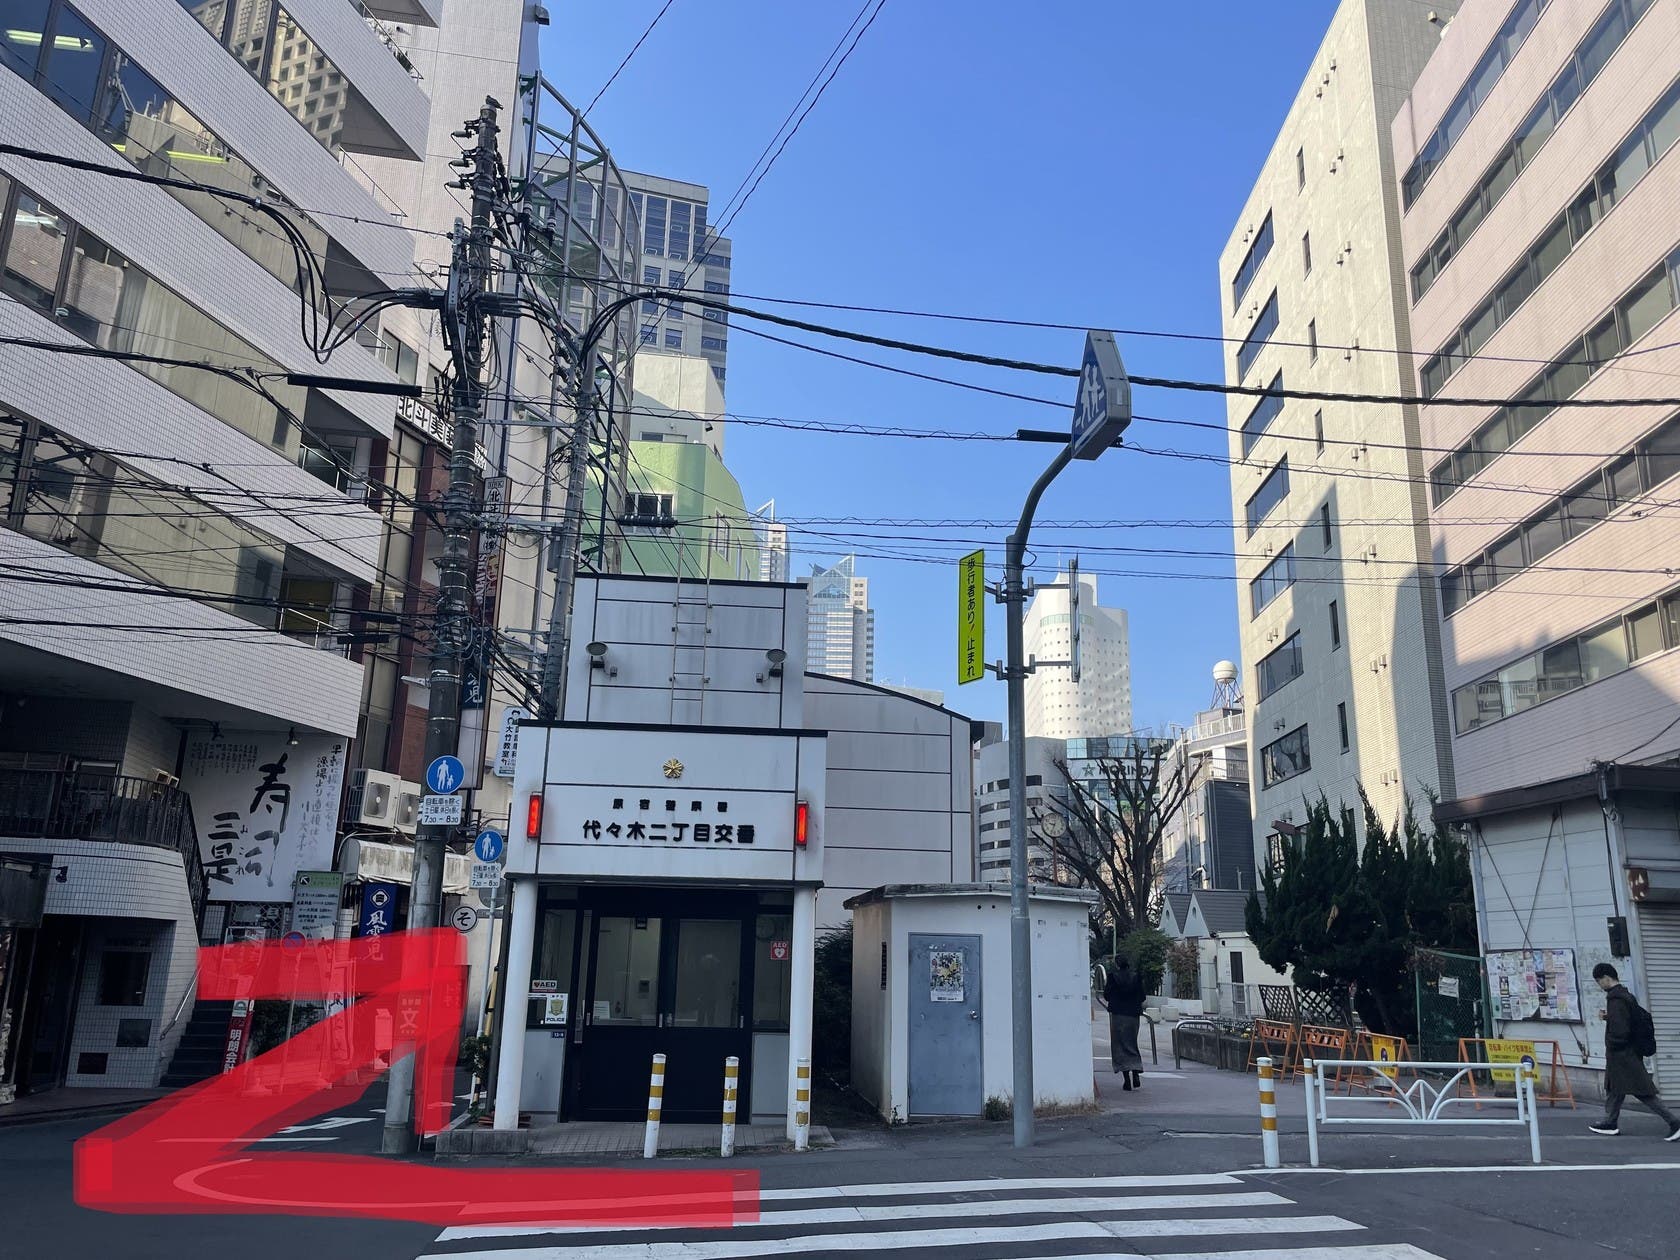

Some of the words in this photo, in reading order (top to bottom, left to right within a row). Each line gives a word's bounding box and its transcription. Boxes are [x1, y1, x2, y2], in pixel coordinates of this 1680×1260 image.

[582, 819, 755, 844] 代々木二丁目交番
[457, 911, 472, 927] そ
